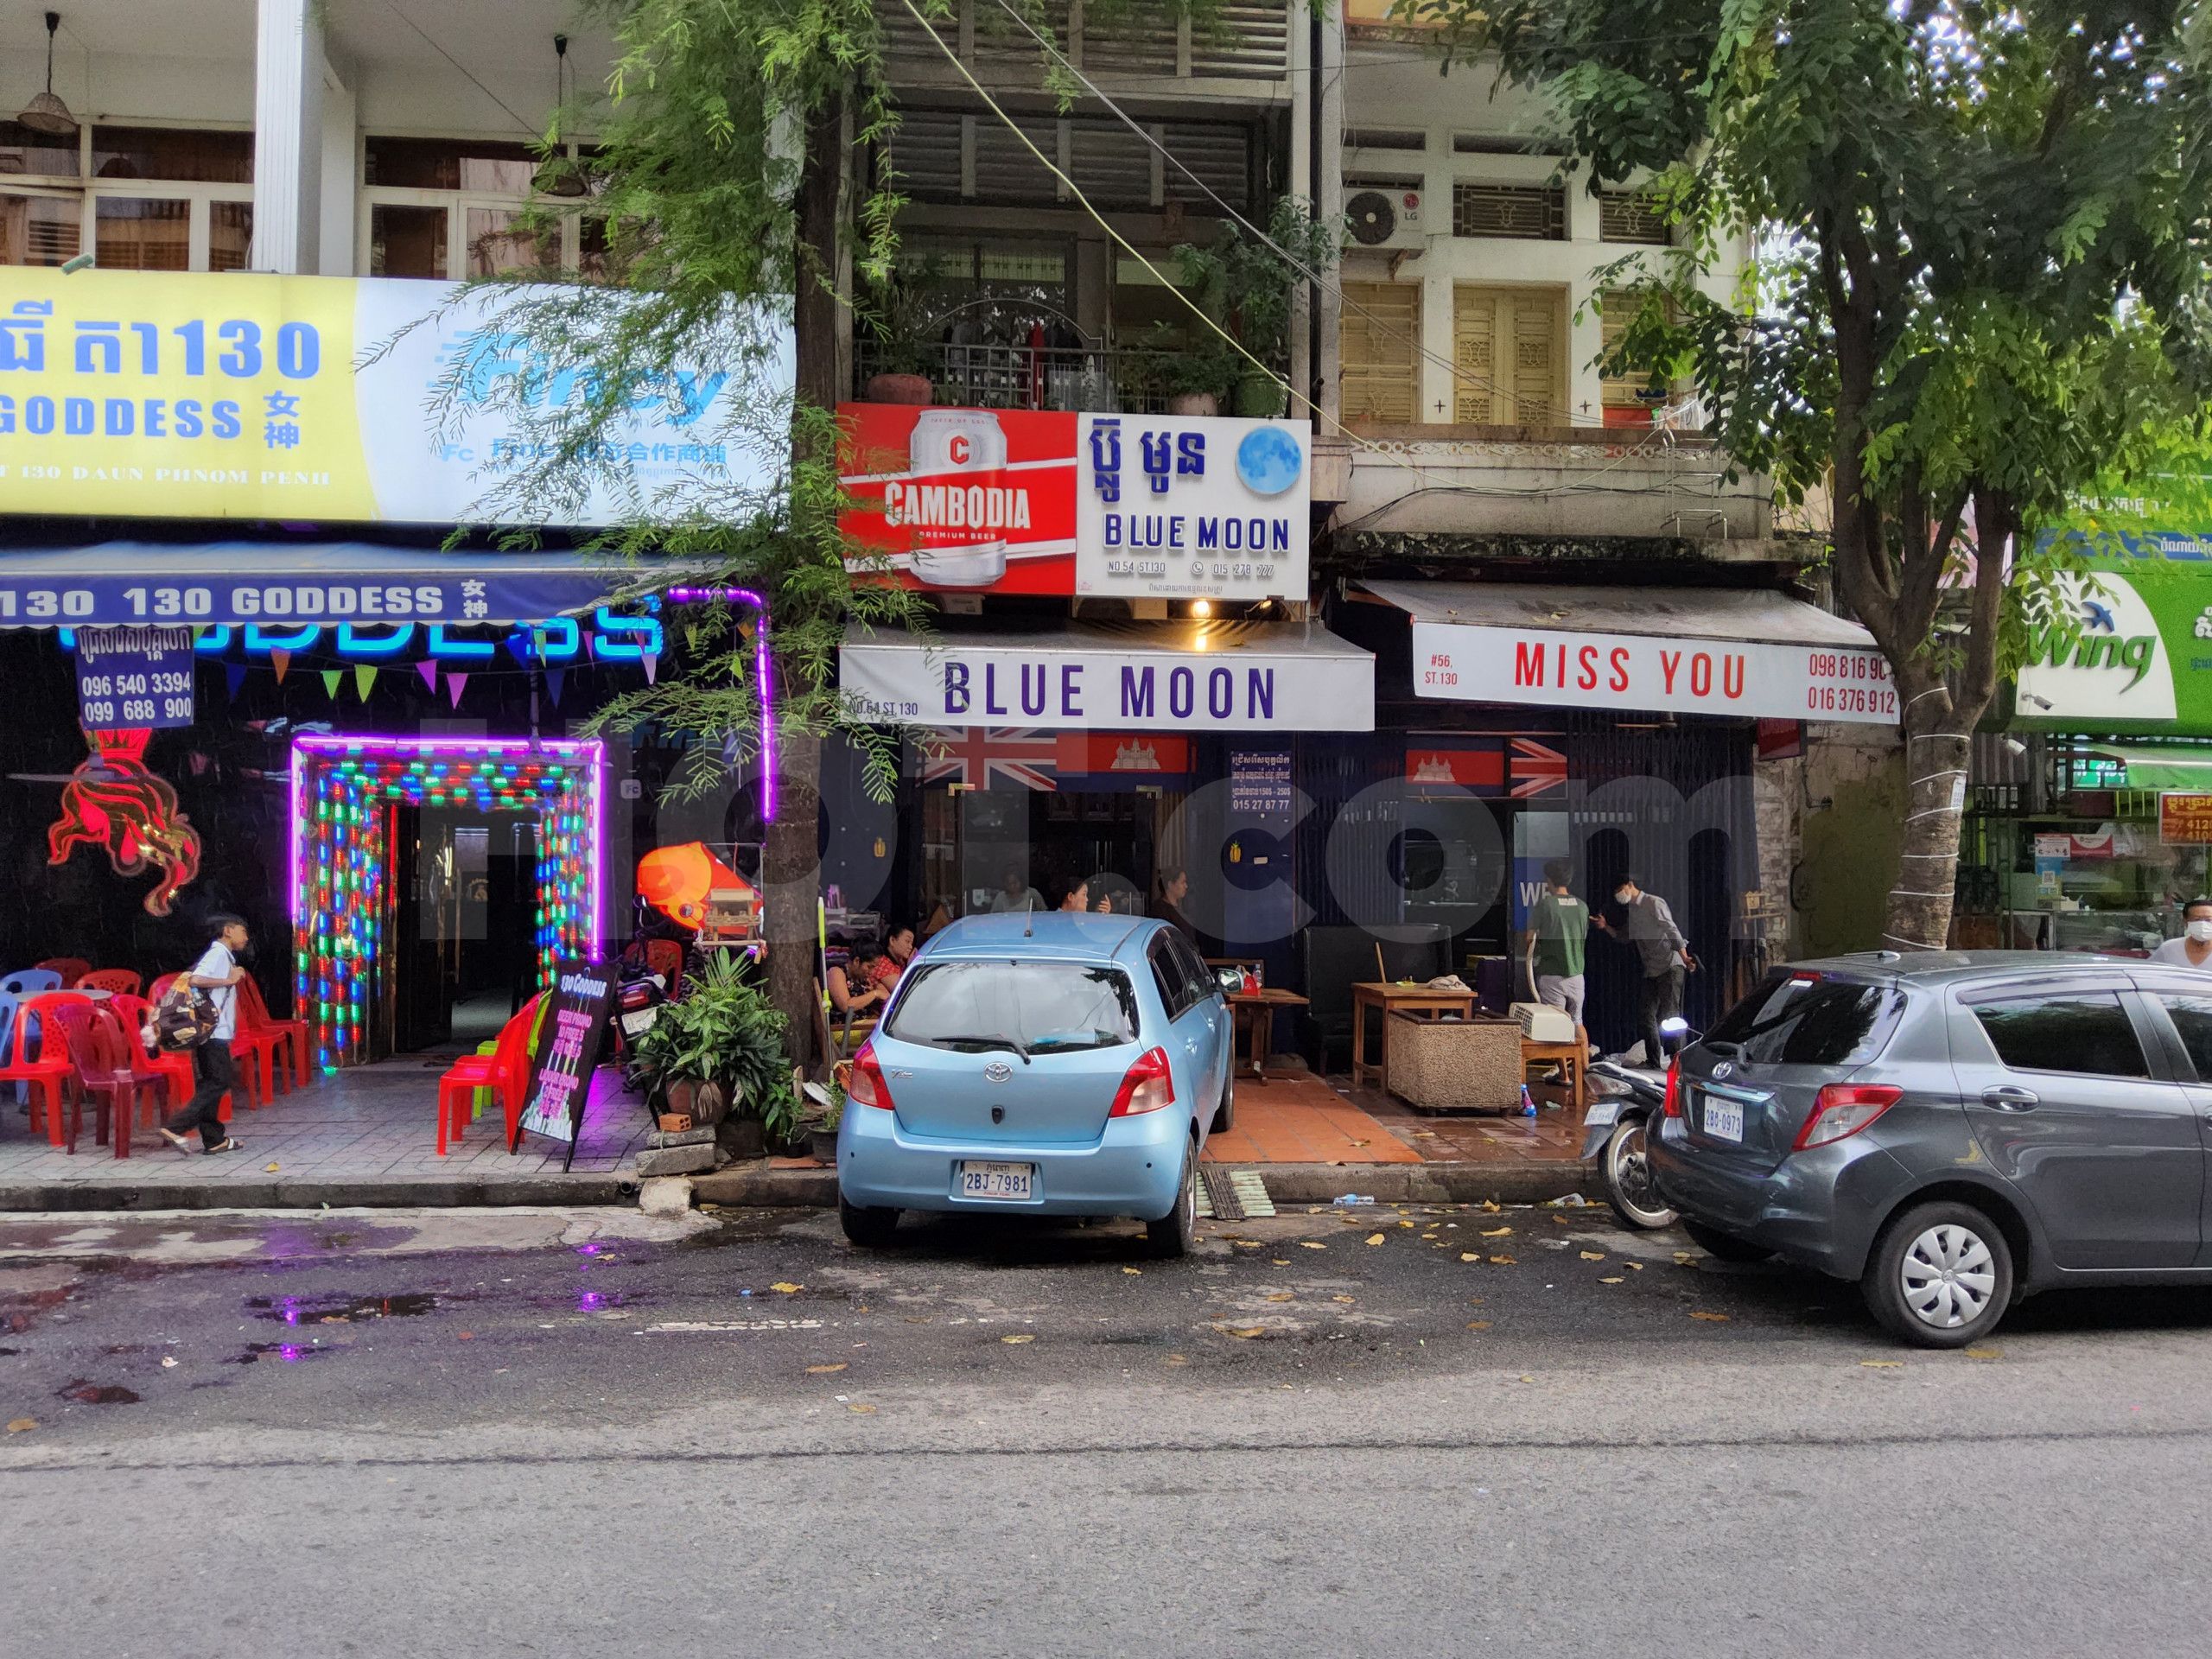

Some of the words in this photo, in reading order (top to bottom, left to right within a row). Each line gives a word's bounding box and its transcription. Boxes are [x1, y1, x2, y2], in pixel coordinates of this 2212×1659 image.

[1404, 212, 1418, 220] LG
[0, 395, 242, 439] GODDESS
[263, 391, 301, 449] 女神
[22, 466, 60, 480] 130
[73, 467, 144, 481] DAUN
[885, 481, 1031, 530] CAMBODIA
[1104, 513, 1185, 549] BLUE
[1197, 516, 1289, 551] MOON
[1213, 563, 1229, 575] 015
[1232, 564, 1252, 575] 278
[1256, 564, 1275, 575] 777
[123, 588, 212, 615] 130
[232, 587, 442, 615] GODDESS
[460, 579, 488, 619] 女神
[1514, 641, 1630, 692] MISS
[1660, 650, 1745, 699] YOU
[1809, 654, 1836, 677] 098
[1840, 656, 1866, 679] 816
[1870, 658, 1889, 681] 90
[82, 676, 111, 696] 096
[116, 674, 147, 695] 540
[151, 671, 191, 694] 3394
[944, 661, 1084, 716] BLUE
[1121, 665, 1274, 720] MOON
[85, 702, 114, 722] 099
[123, 699, 156, 721] 688
[165, 696, 192, 718] 900
[1808, 687, 1835, 710] 016
[1839, 689, 1866, 712] 376
[1868, 690, 1895, 714] 912
[1233, 799, 1249, 810] 015
[1252, 799, 1262, 810] 27
[1265, 799, 1276, 810] 87
[1279, 799, 1289, 810] 77
[2187, 819, 2212, 830] 412
[966, 1173, 1028, 1192] 2BJ-7981
